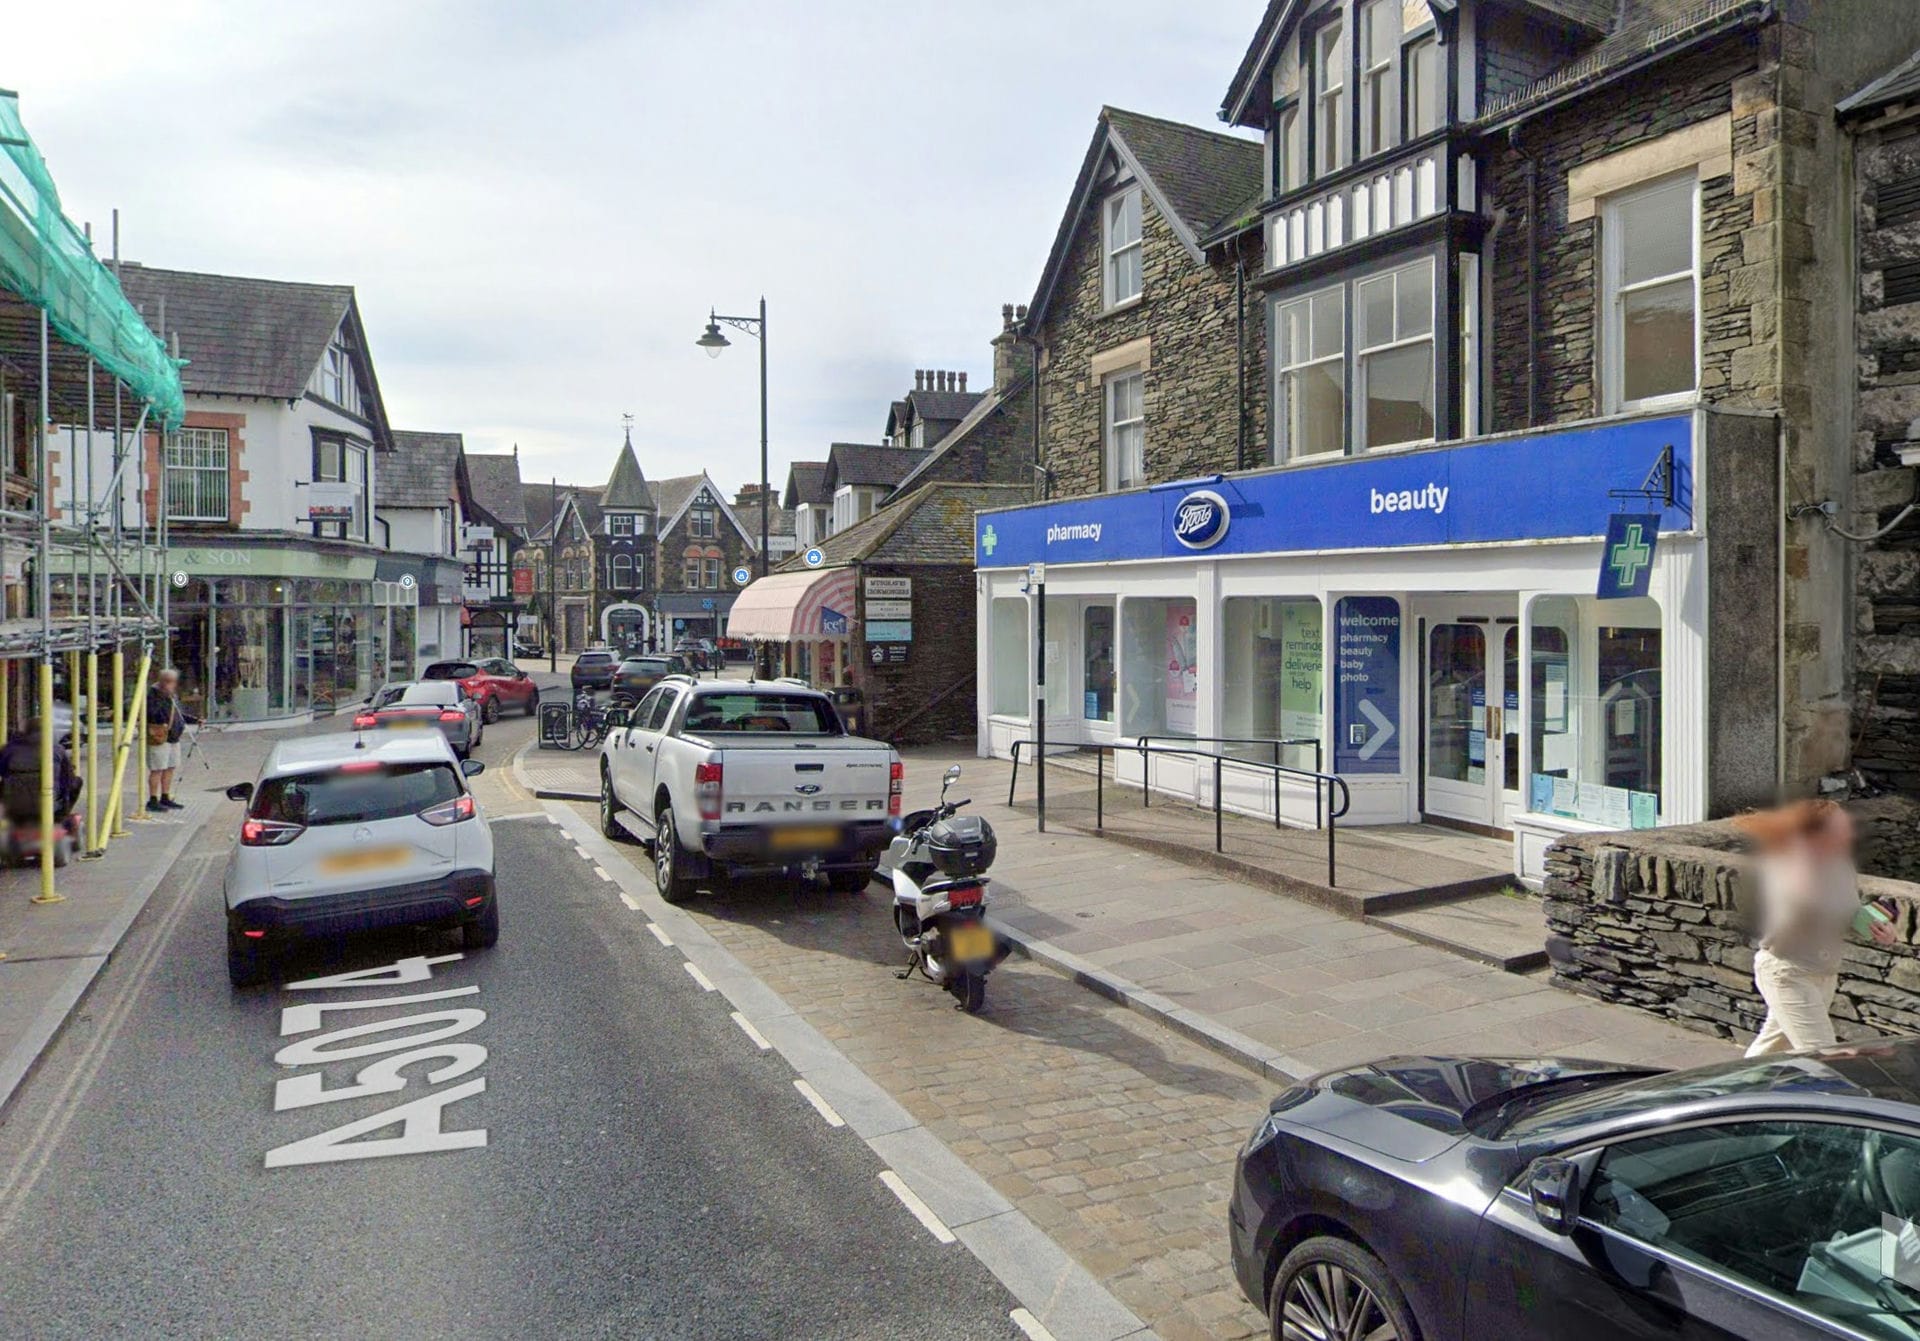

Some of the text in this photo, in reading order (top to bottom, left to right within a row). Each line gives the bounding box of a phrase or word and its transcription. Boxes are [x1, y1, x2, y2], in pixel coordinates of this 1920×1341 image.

[1370, 482, 1449, 514] beauty
[1178, 503, 1212, 535] Boots
[1047, 523, 1102, 545] pharmacy
[184, 550, 200, 565] &
[207, 550, 251, 565] SON
[1340, 614, 1399, 626] welcome
[1301, 627, 1320, 639] text
[1340, 633, 1388, 643] pharmacy
[1340, 646, 1373, 657] beauty
[1340, 660, 1364, 670] baby
[1292, 676, 1311, 693] help
[1340, 673, 1369, 683] photo
[725, 800, 884, 813] RANGER
[264, 952, 488, 1168] A5074
